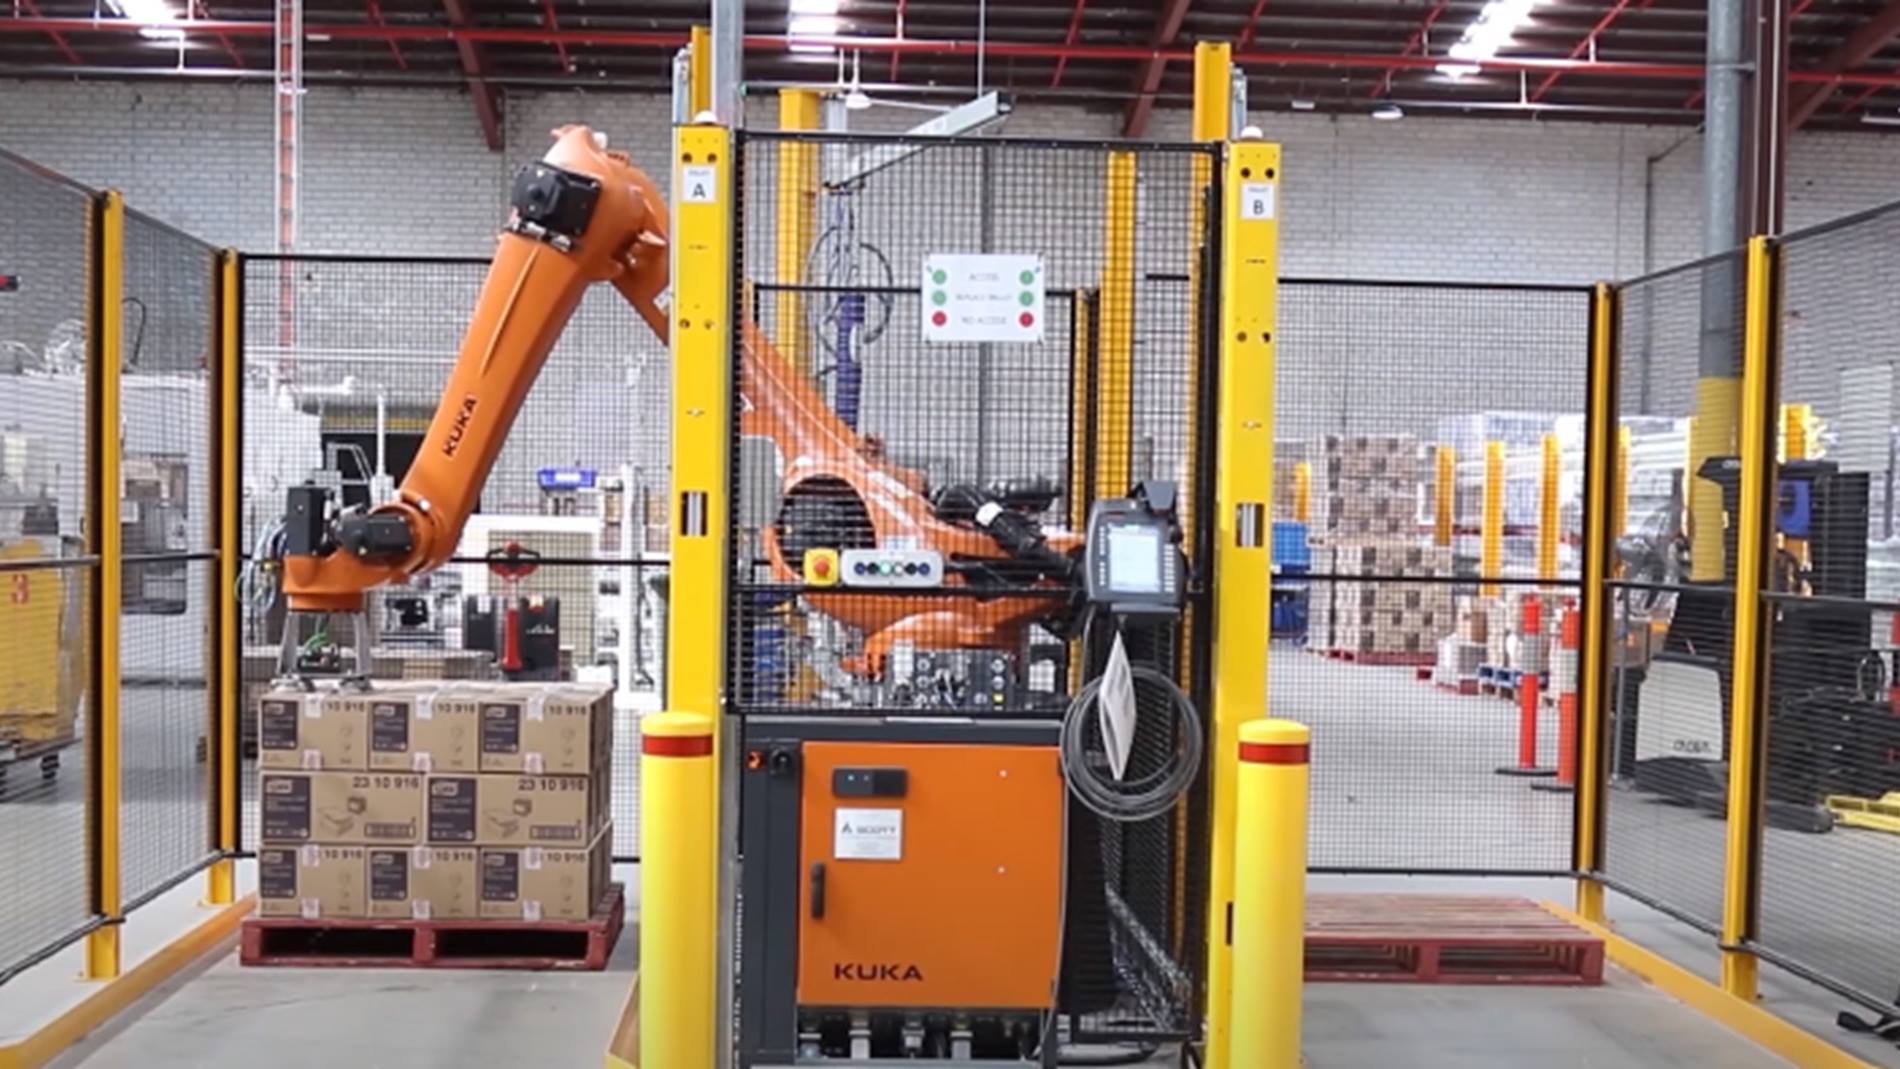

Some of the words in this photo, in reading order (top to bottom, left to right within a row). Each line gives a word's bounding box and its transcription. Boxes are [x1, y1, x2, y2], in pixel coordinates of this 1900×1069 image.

[691, 182, 706, 198] A
[1253, 199, 1264, 215] B
[442, 399, 477, 457] KUKA
[11, 573, 28, 605] 3
[353, 777, 370, 789] 23
[375, 777, 391, 789] 10
[518, 779, 535, 791] 23
[541, 779, 557, 791] 10
[834, 963, 923, 981] KUKA
